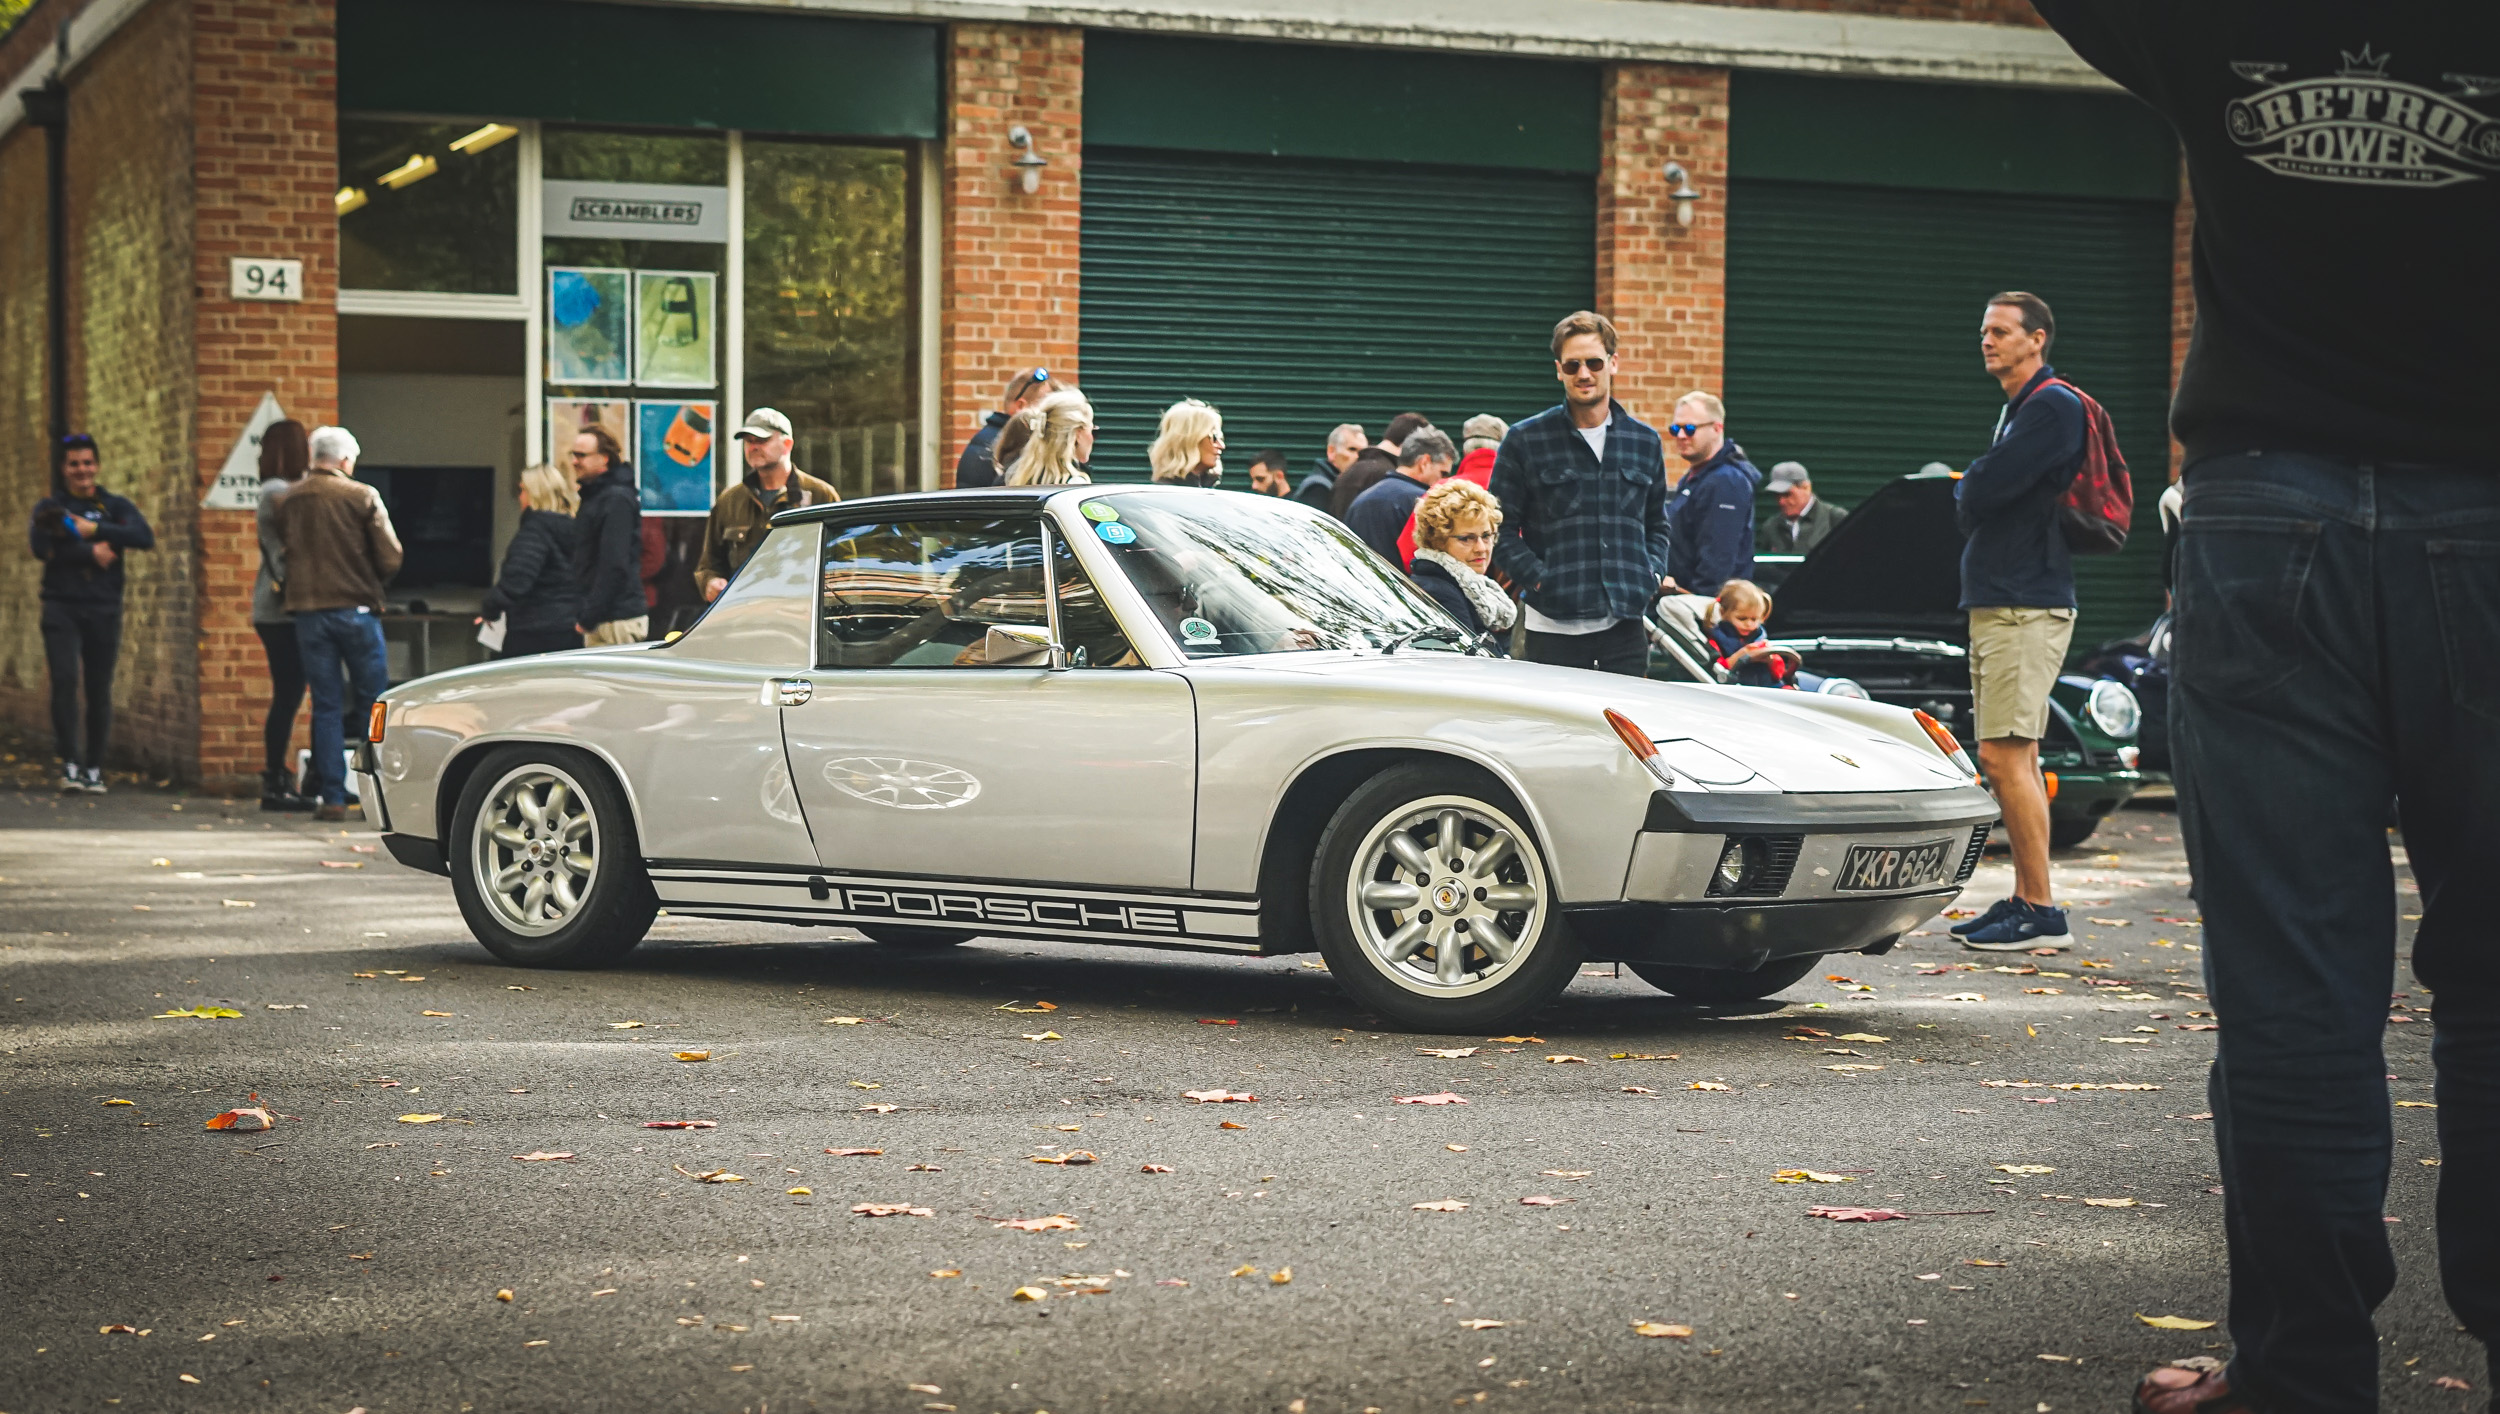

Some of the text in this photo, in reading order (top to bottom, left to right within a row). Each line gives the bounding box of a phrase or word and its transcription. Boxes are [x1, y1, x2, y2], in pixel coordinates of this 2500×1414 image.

[2256, 86, 2469, 145] RETRO
[2283, 127, 2427, 167] POWER
[577, 203, 696, 221] SCRAMBLERS
[246, 264, 288, 295] 94
[1846, 843, 1953, 888] YKR 662J
[846, 889, 1179, 932] PORSCHE
